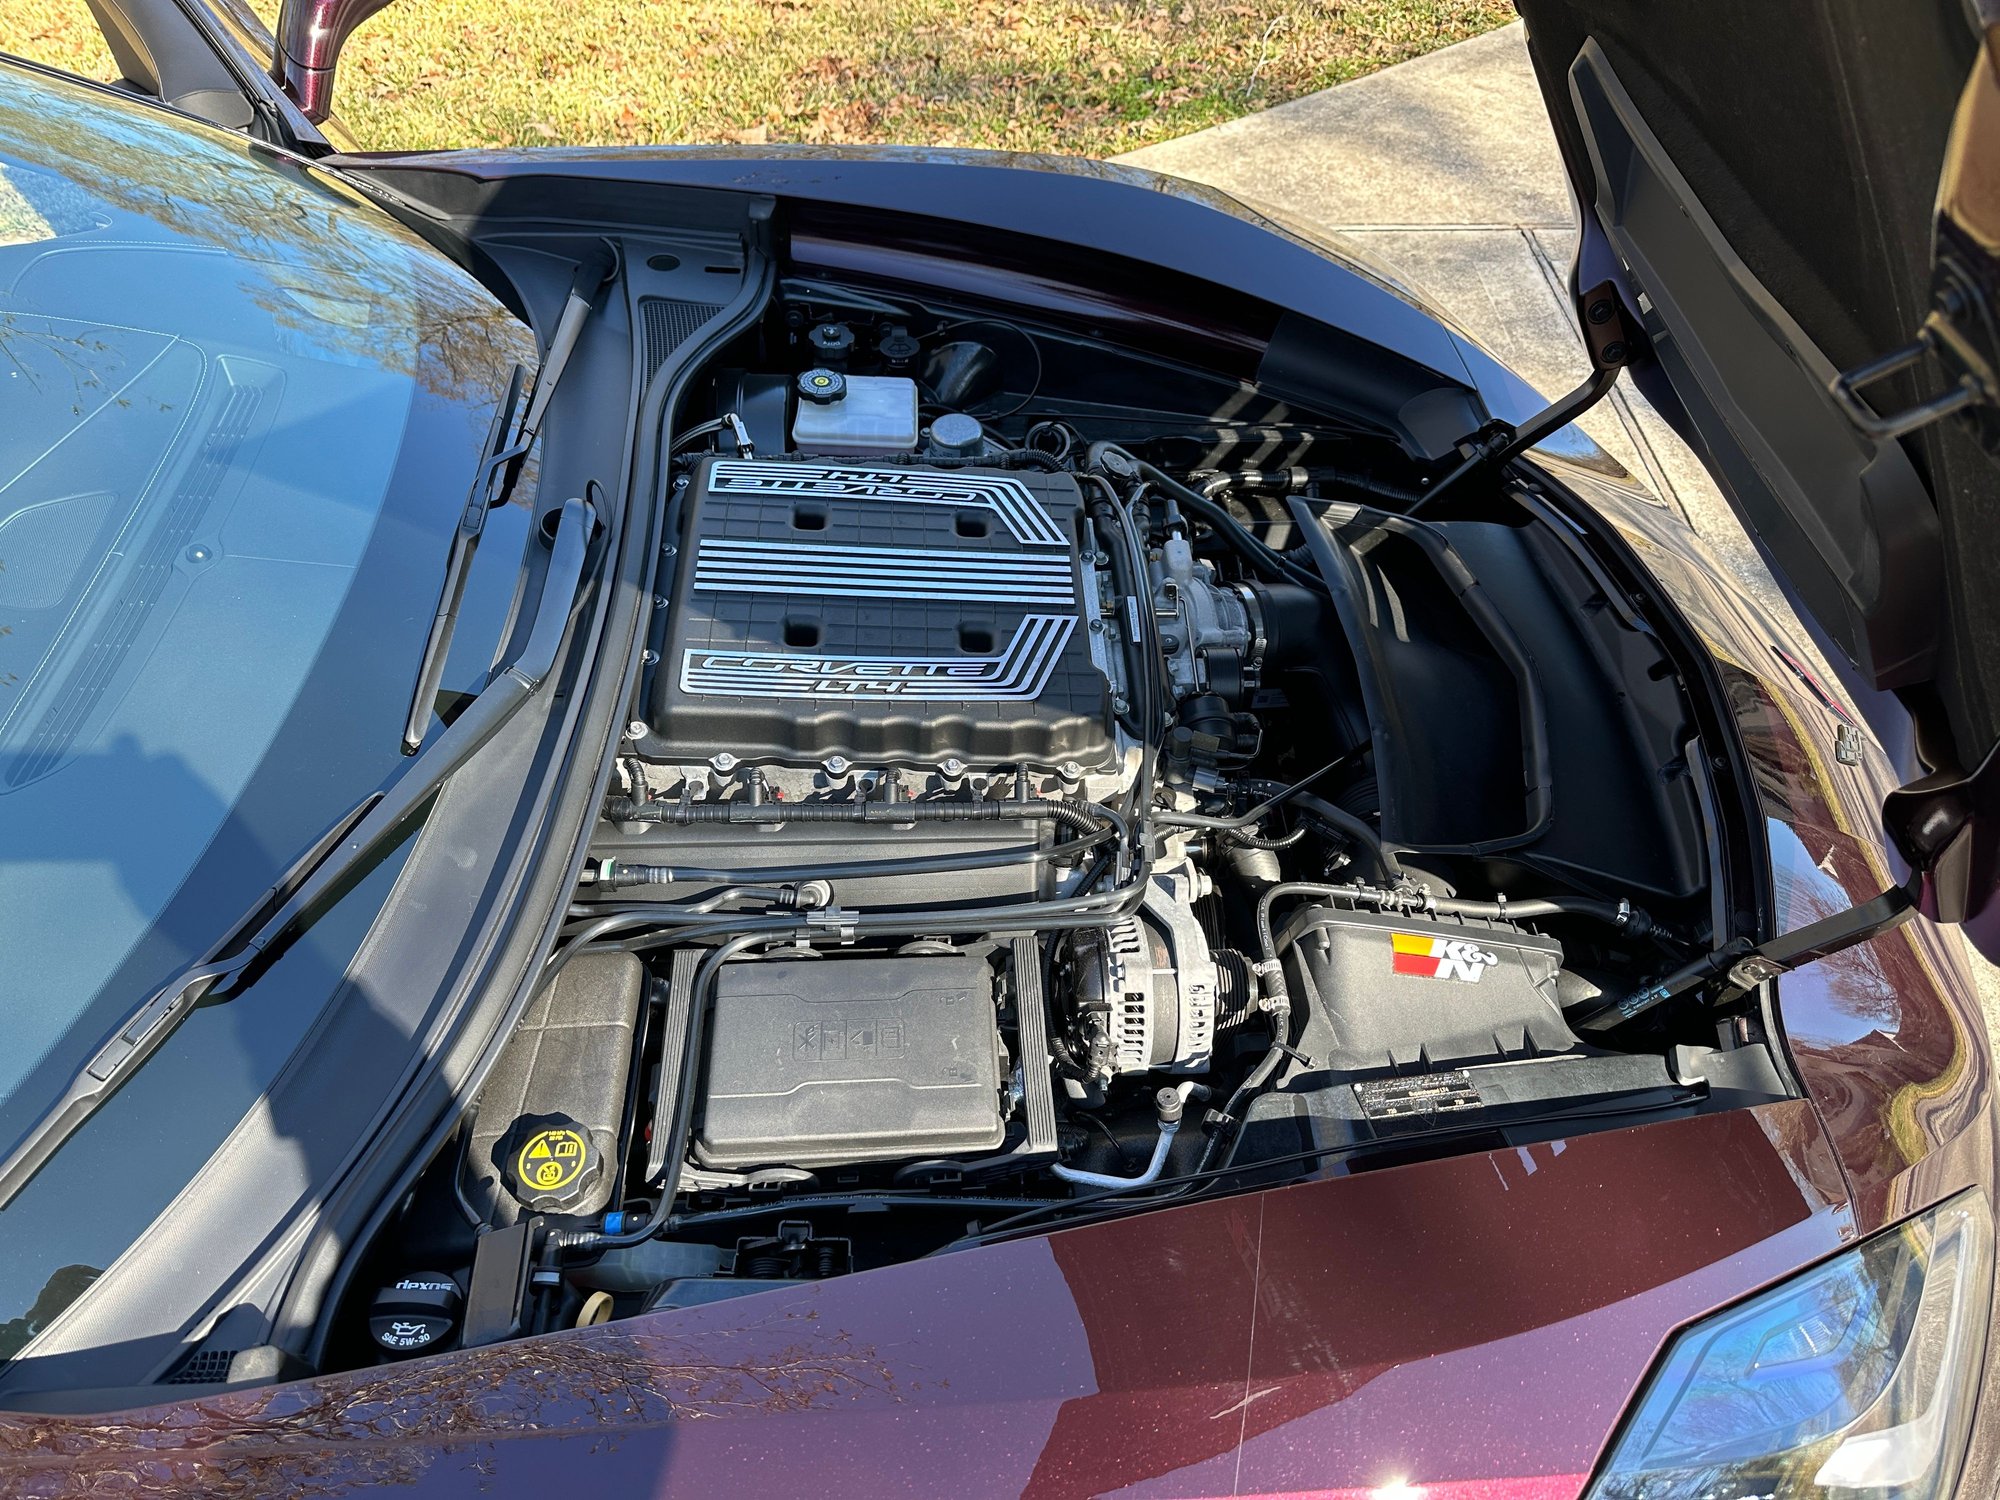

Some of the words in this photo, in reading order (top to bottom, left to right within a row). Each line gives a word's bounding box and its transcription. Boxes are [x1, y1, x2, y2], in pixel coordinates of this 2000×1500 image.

[828, 471, 902, 483] LT4
[725, 478, 977, 500] CORVETTE
[701, 656, 987, 676] CORVETTE
[815, 680, 902, 693] LT4
[1430, 938, 1498, 983] K&N
[381, 1332, 399, 1345] SAE
[400, 1333, 431, 1346] 5W-30
